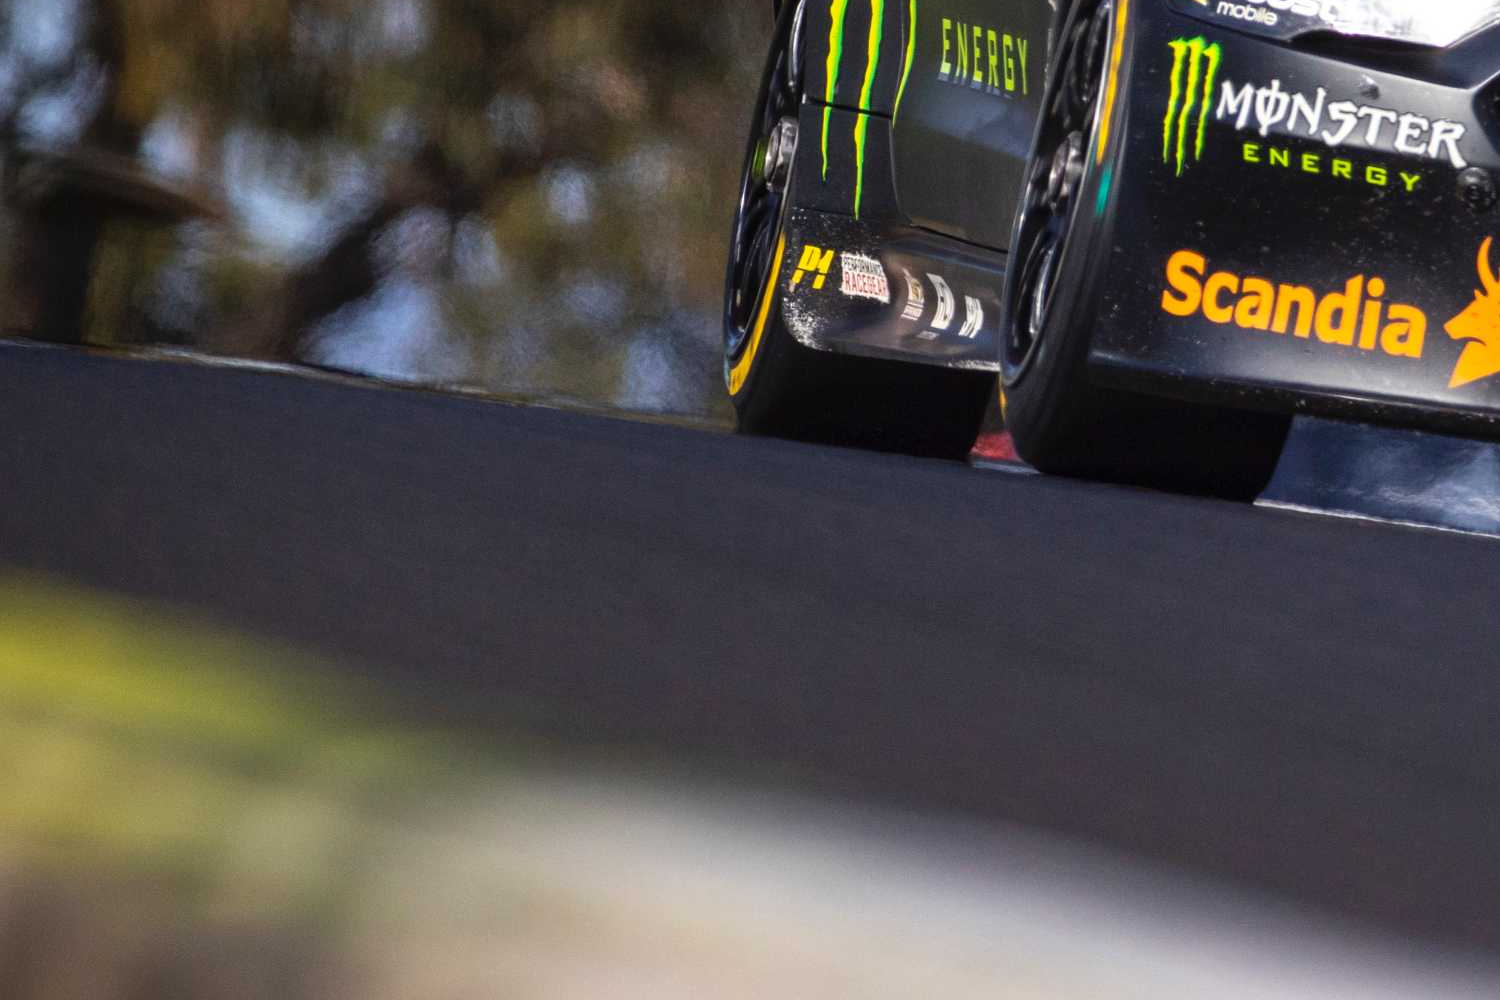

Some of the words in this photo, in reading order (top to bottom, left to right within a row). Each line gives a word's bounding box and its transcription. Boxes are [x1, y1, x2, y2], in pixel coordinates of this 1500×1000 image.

[1216, 1, 1278, 26] mobile
[938, 16, 1029, 96] ENERGY
[1216, 79, 1468, 168] MONSTER
[1243, 143, 1422, 193] ENERGY
[1160, 248, 1428, 359] Scandia
